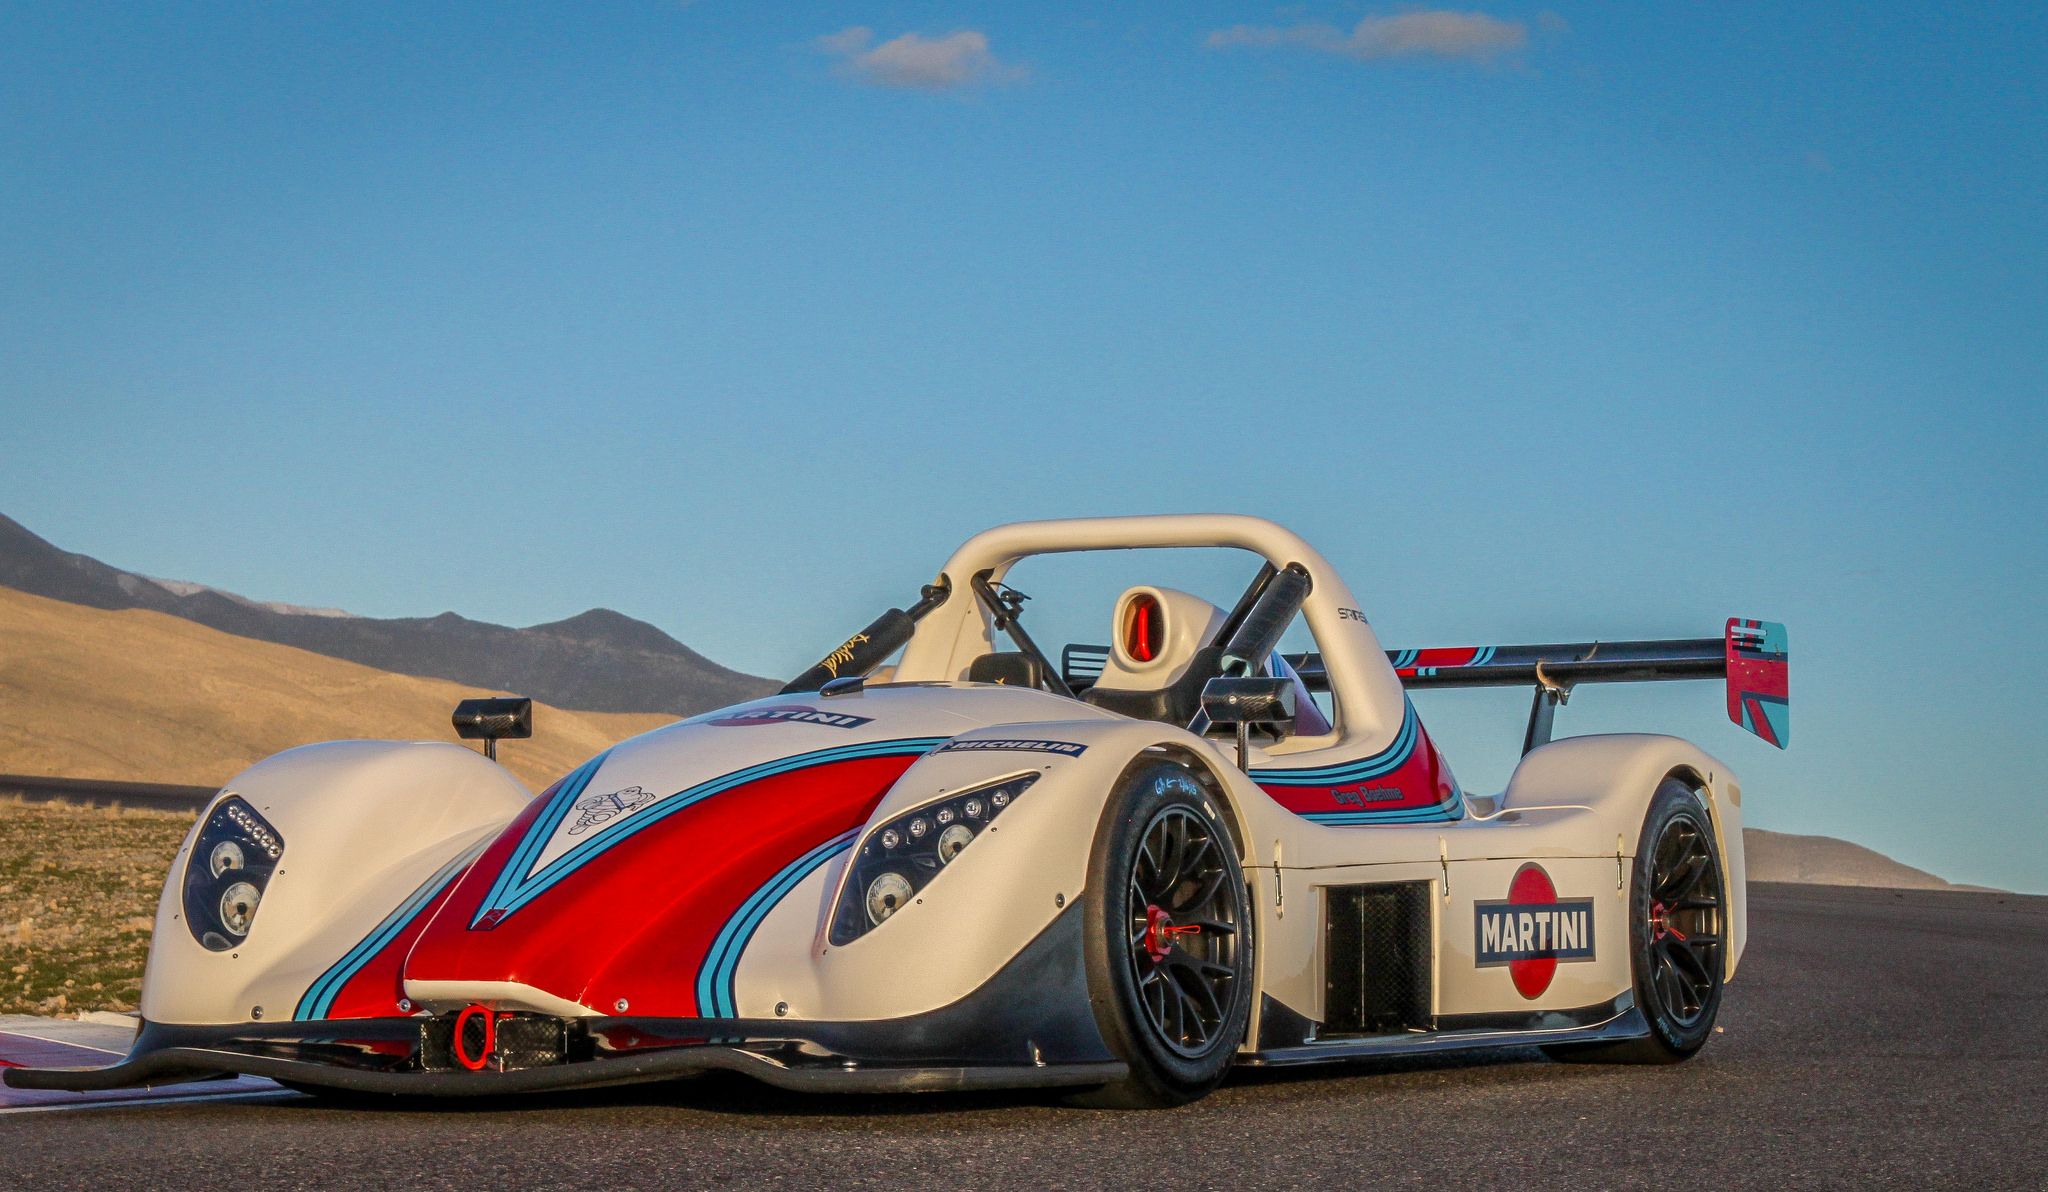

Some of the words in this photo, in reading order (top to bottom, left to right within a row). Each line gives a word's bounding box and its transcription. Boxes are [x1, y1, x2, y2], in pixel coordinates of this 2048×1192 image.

[952, 740, 1081, 752] MICHELIN
[1330, 789, 1366, 808] Greg
[1481, 911, 1588, 954] MARTINI
